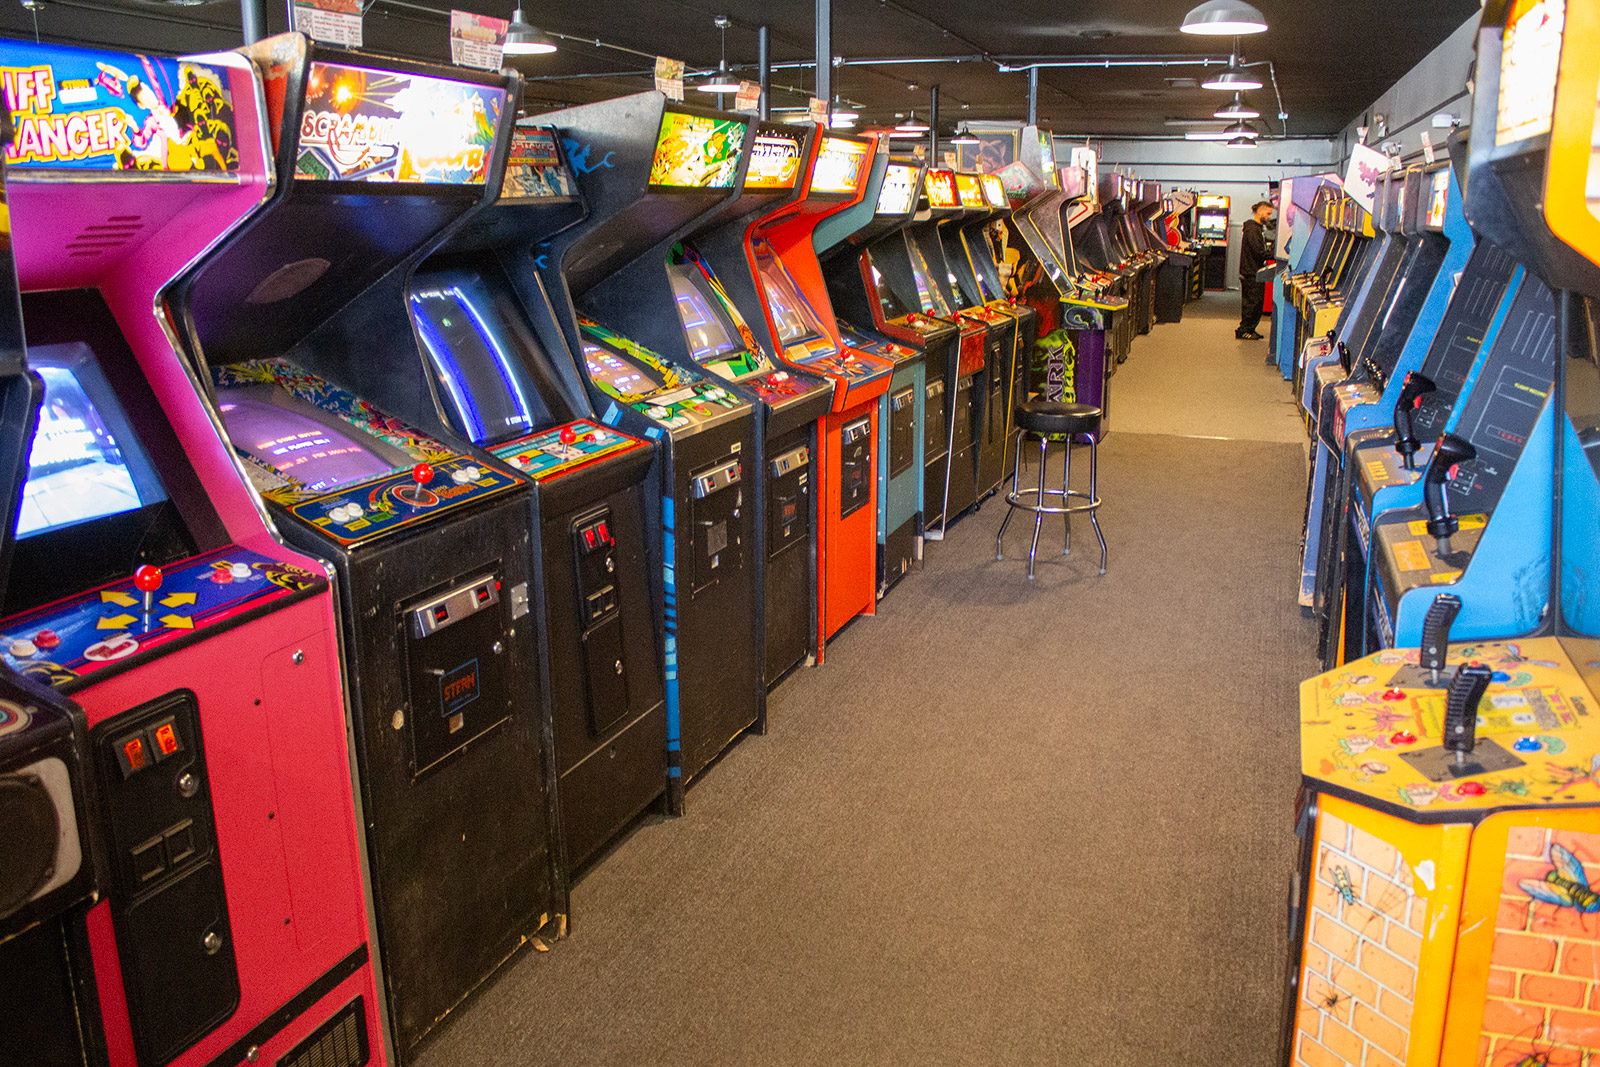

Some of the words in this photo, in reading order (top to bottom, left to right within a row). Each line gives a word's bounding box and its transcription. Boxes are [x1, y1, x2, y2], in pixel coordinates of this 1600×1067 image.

[1, 67, 54, 113] IFF
[8, 110, 128, 160] ANGER
[1046, 343, 1065, 402] ARK
[1063, 332, 1076, 403] gacy
[444, 672, 475, 701] STERN
